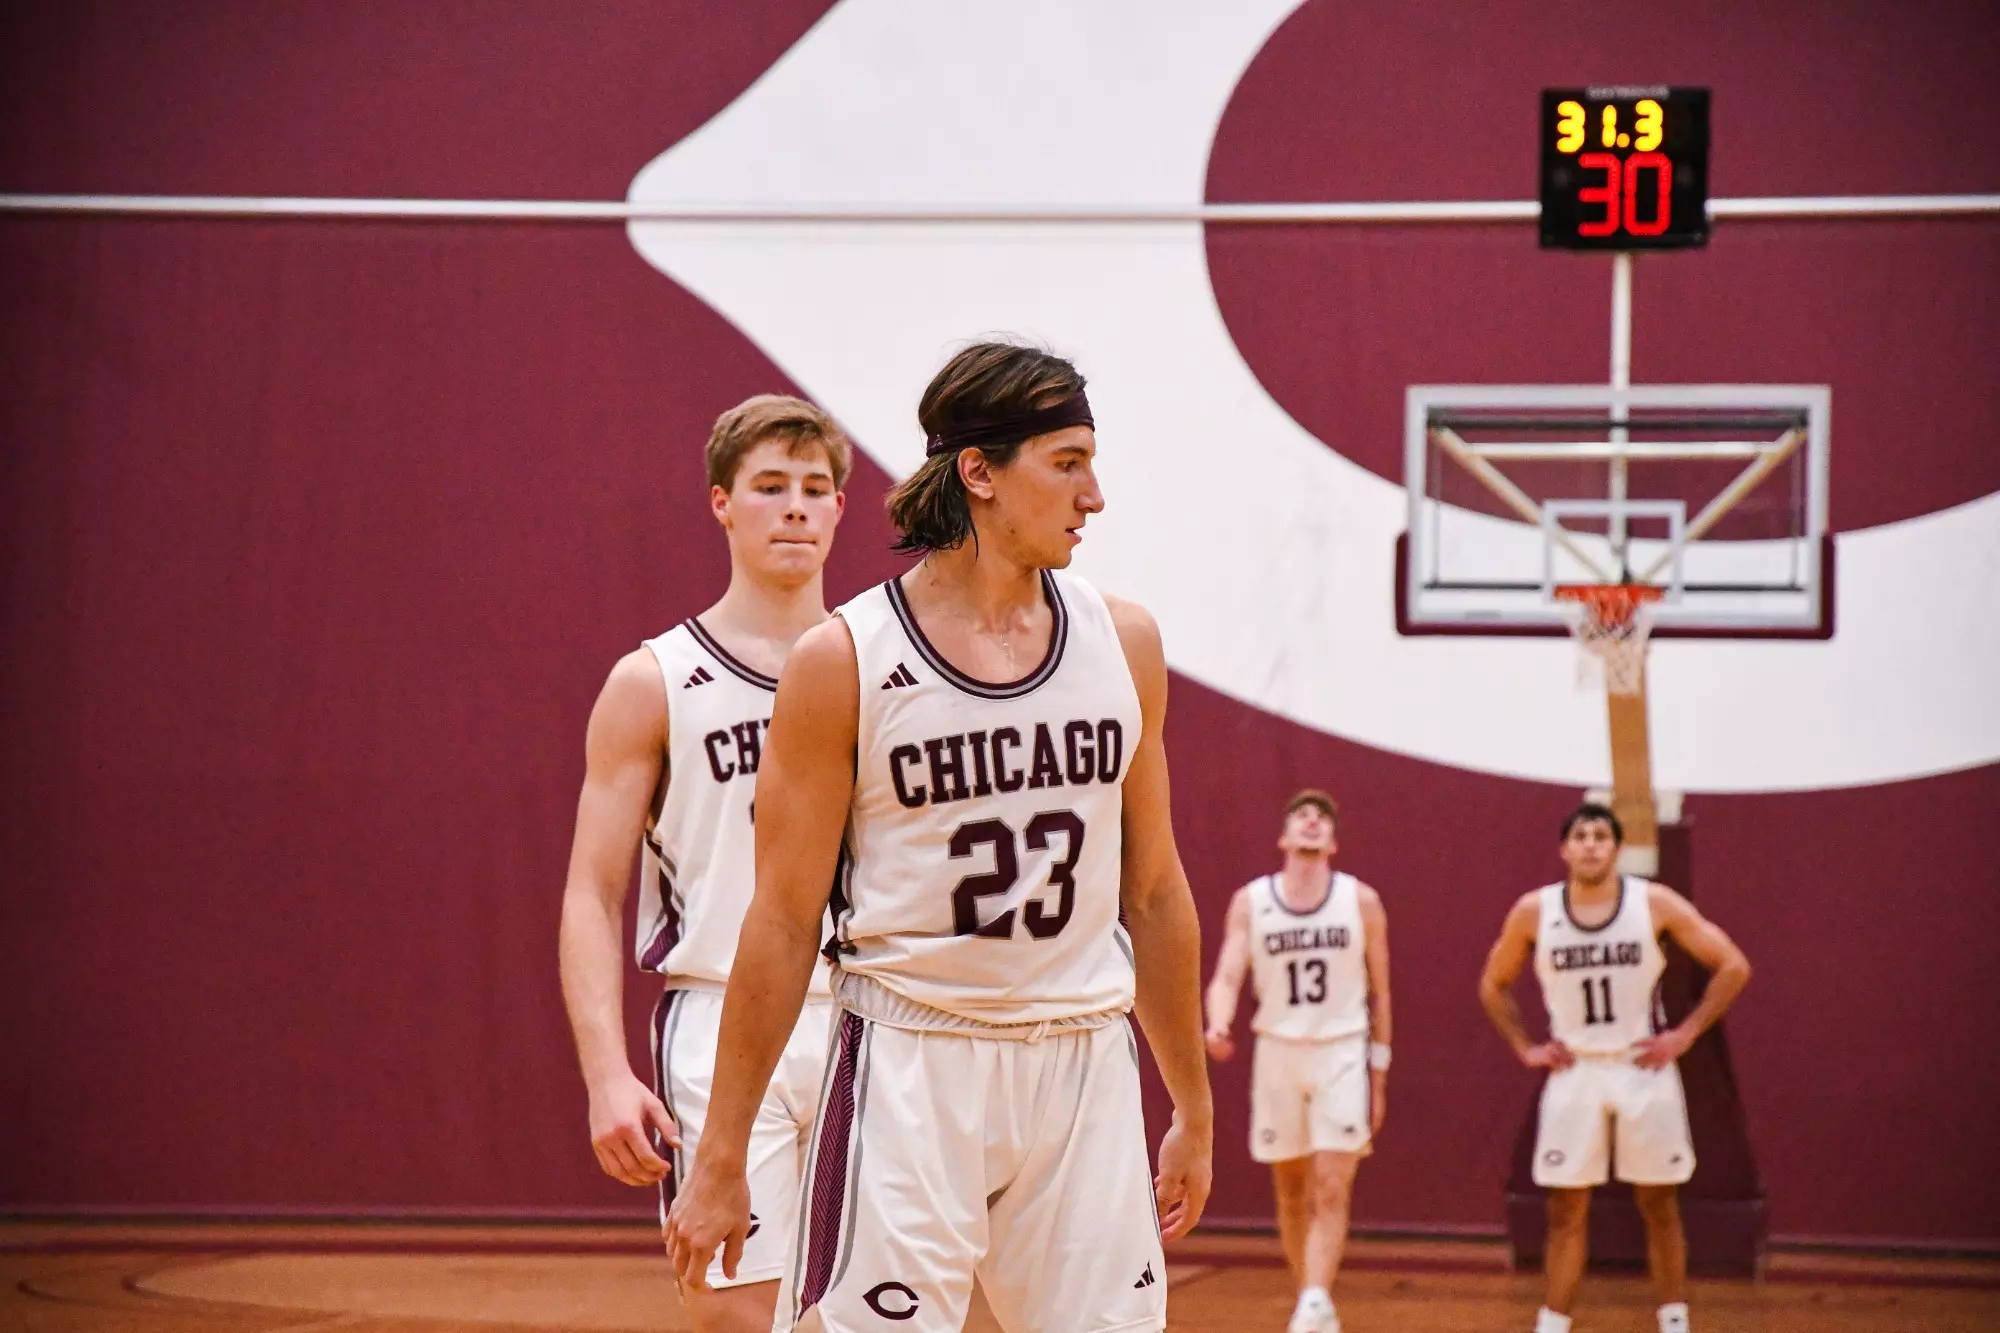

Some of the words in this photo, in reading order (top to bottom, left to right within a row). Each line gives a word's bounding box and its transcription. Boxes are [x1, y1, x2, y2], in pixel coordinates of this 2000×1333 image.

[1556, 99, 1664, 153] 31.3
[1578, 152, 1673, 237] 30
[889, 718, 1123, 809] CHICAGO
[947, 808, 1087, 941] 23
[1264, 925, 1350, 957] CHICAGO
[1551, 940, 1642, 972] CHICAGO
[1286, 957, 1328, 1007] 13
[1581, 976, 1616, 1027] 11
[863, 1281, 919, 1321] C
